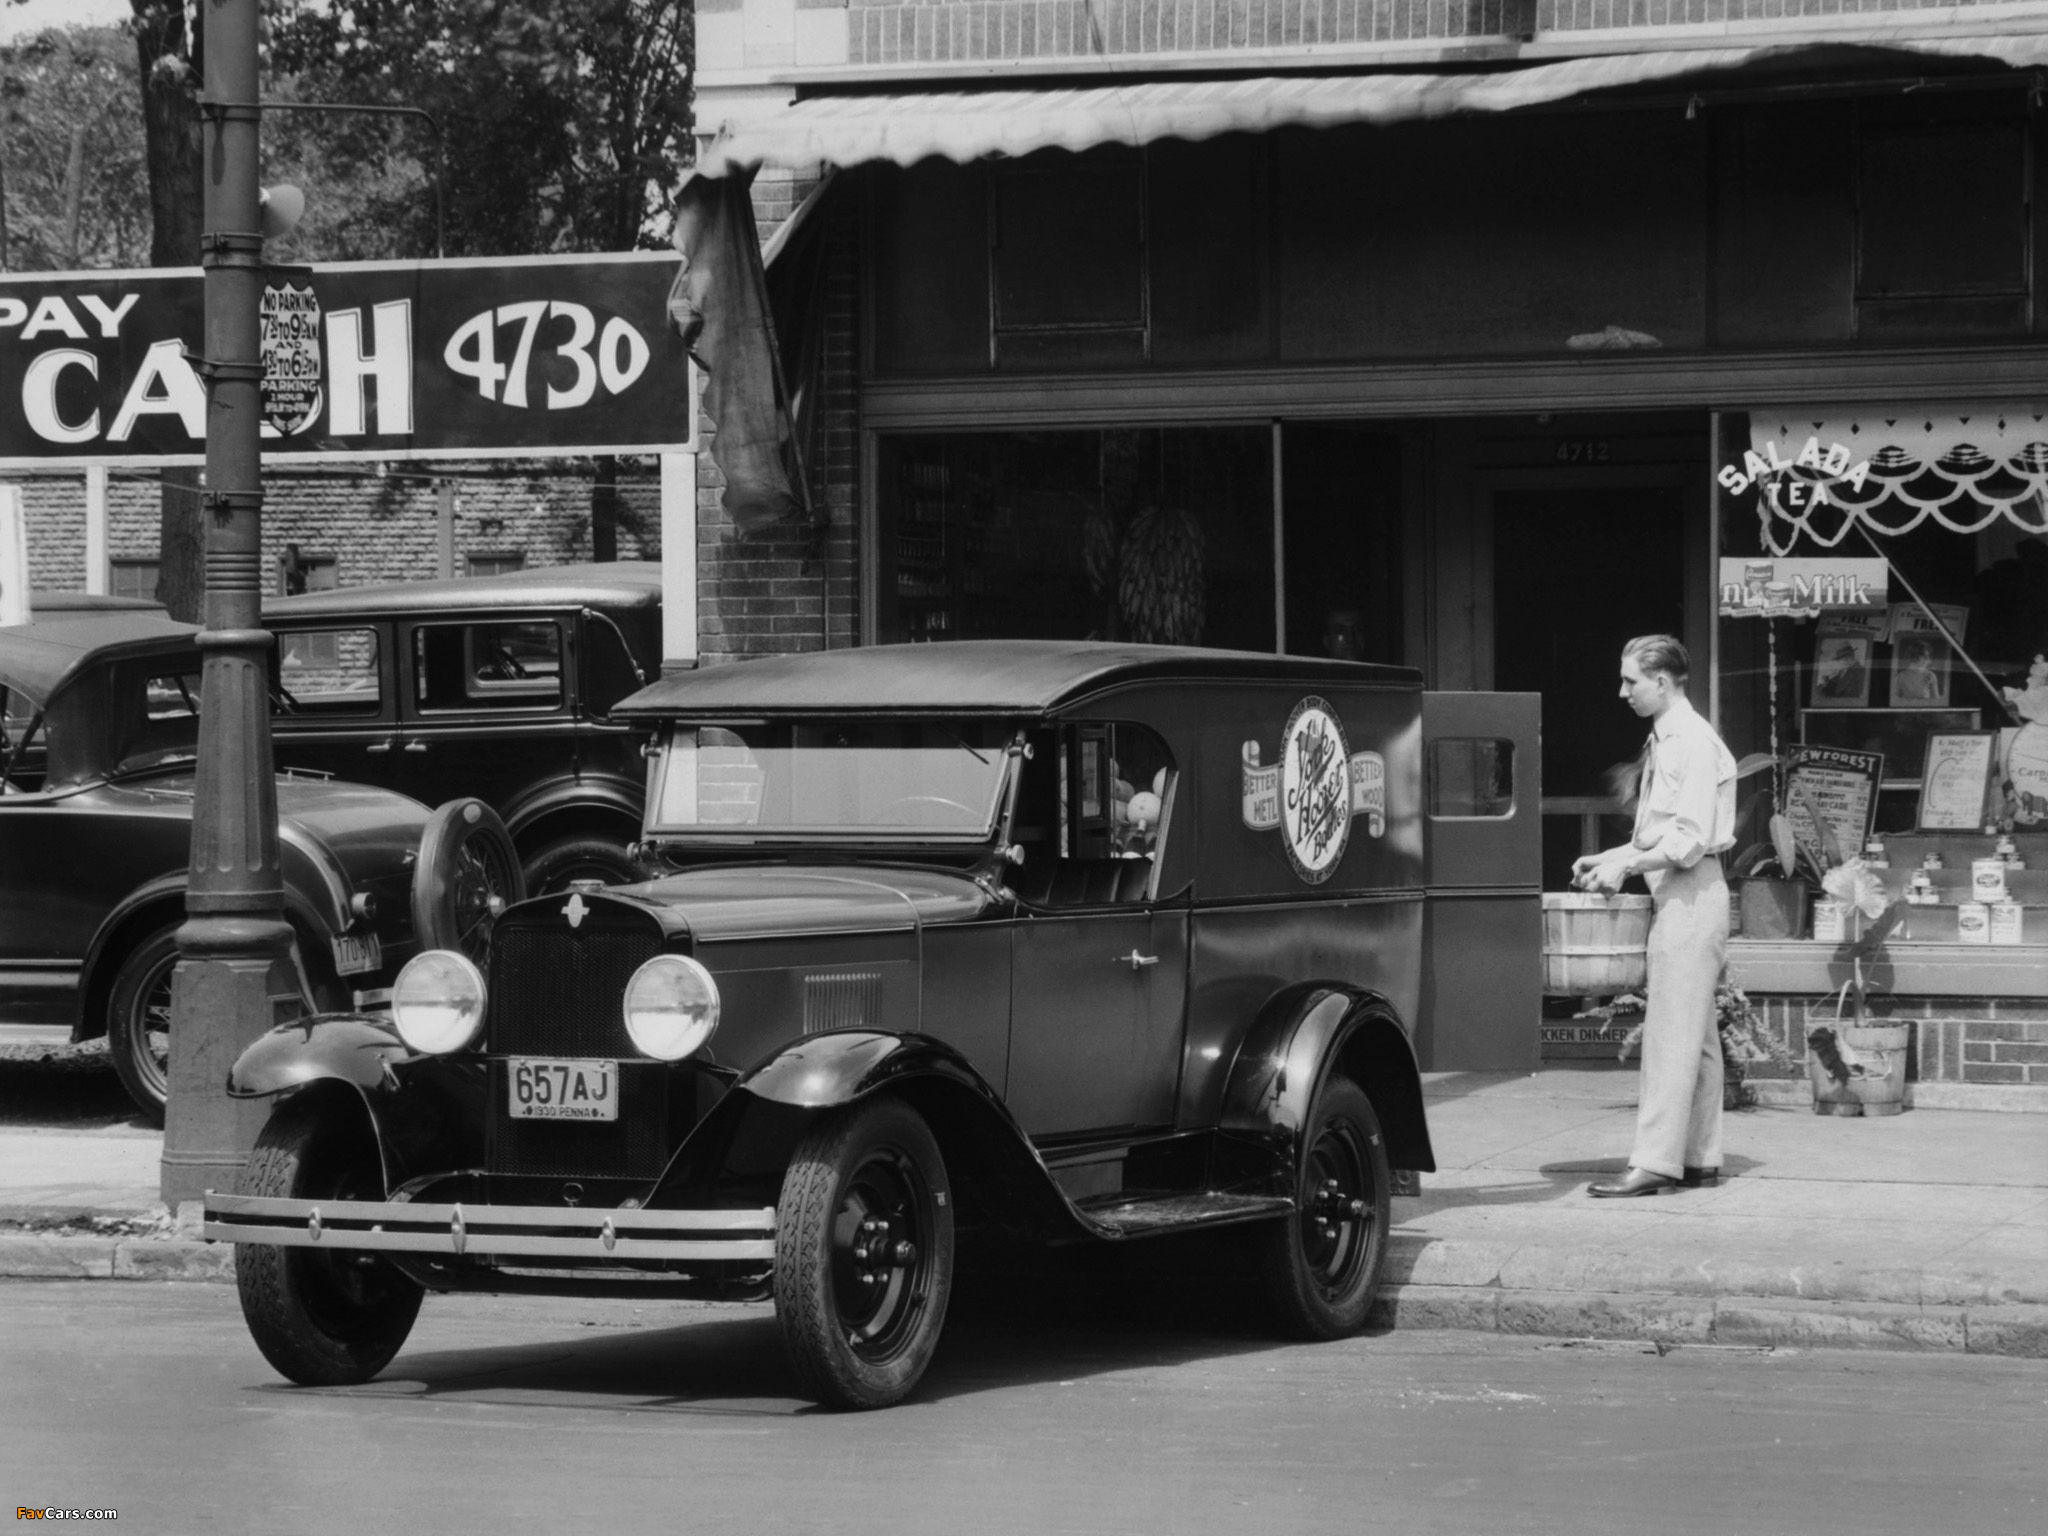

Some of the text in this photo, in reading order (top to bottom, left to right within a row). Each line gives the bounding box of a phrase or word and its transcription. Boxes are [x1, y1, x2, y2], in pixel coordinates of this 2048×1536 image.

[264, 293, 316, 312] NO PARKING
[0, 294, 139, 339] PAY
[276, 341, 302, 349] AND
[444, 300, 650, 410] 4730
[260, 380, 316, 392] PARKING
[277, 393, 304, 402] HOUR
[1556, 441, 1610, 461] 4712
[1718, 437, 1871, 496] SALADA
[1767, 482, 1829, 506] TEA
[1792, 574, 1872, 605] Milk
[1914, 618, 1940, 631] FRE
[1354, 760, 1383, 784] BETTER
[1791, 749, 1876, 772] EWFOREST
[1243, 773, 1277, 796] BETTER
[516, 1064, 608, 1105] 657AJ
[534, 1106, 591, 1118] 1930 PENNA
